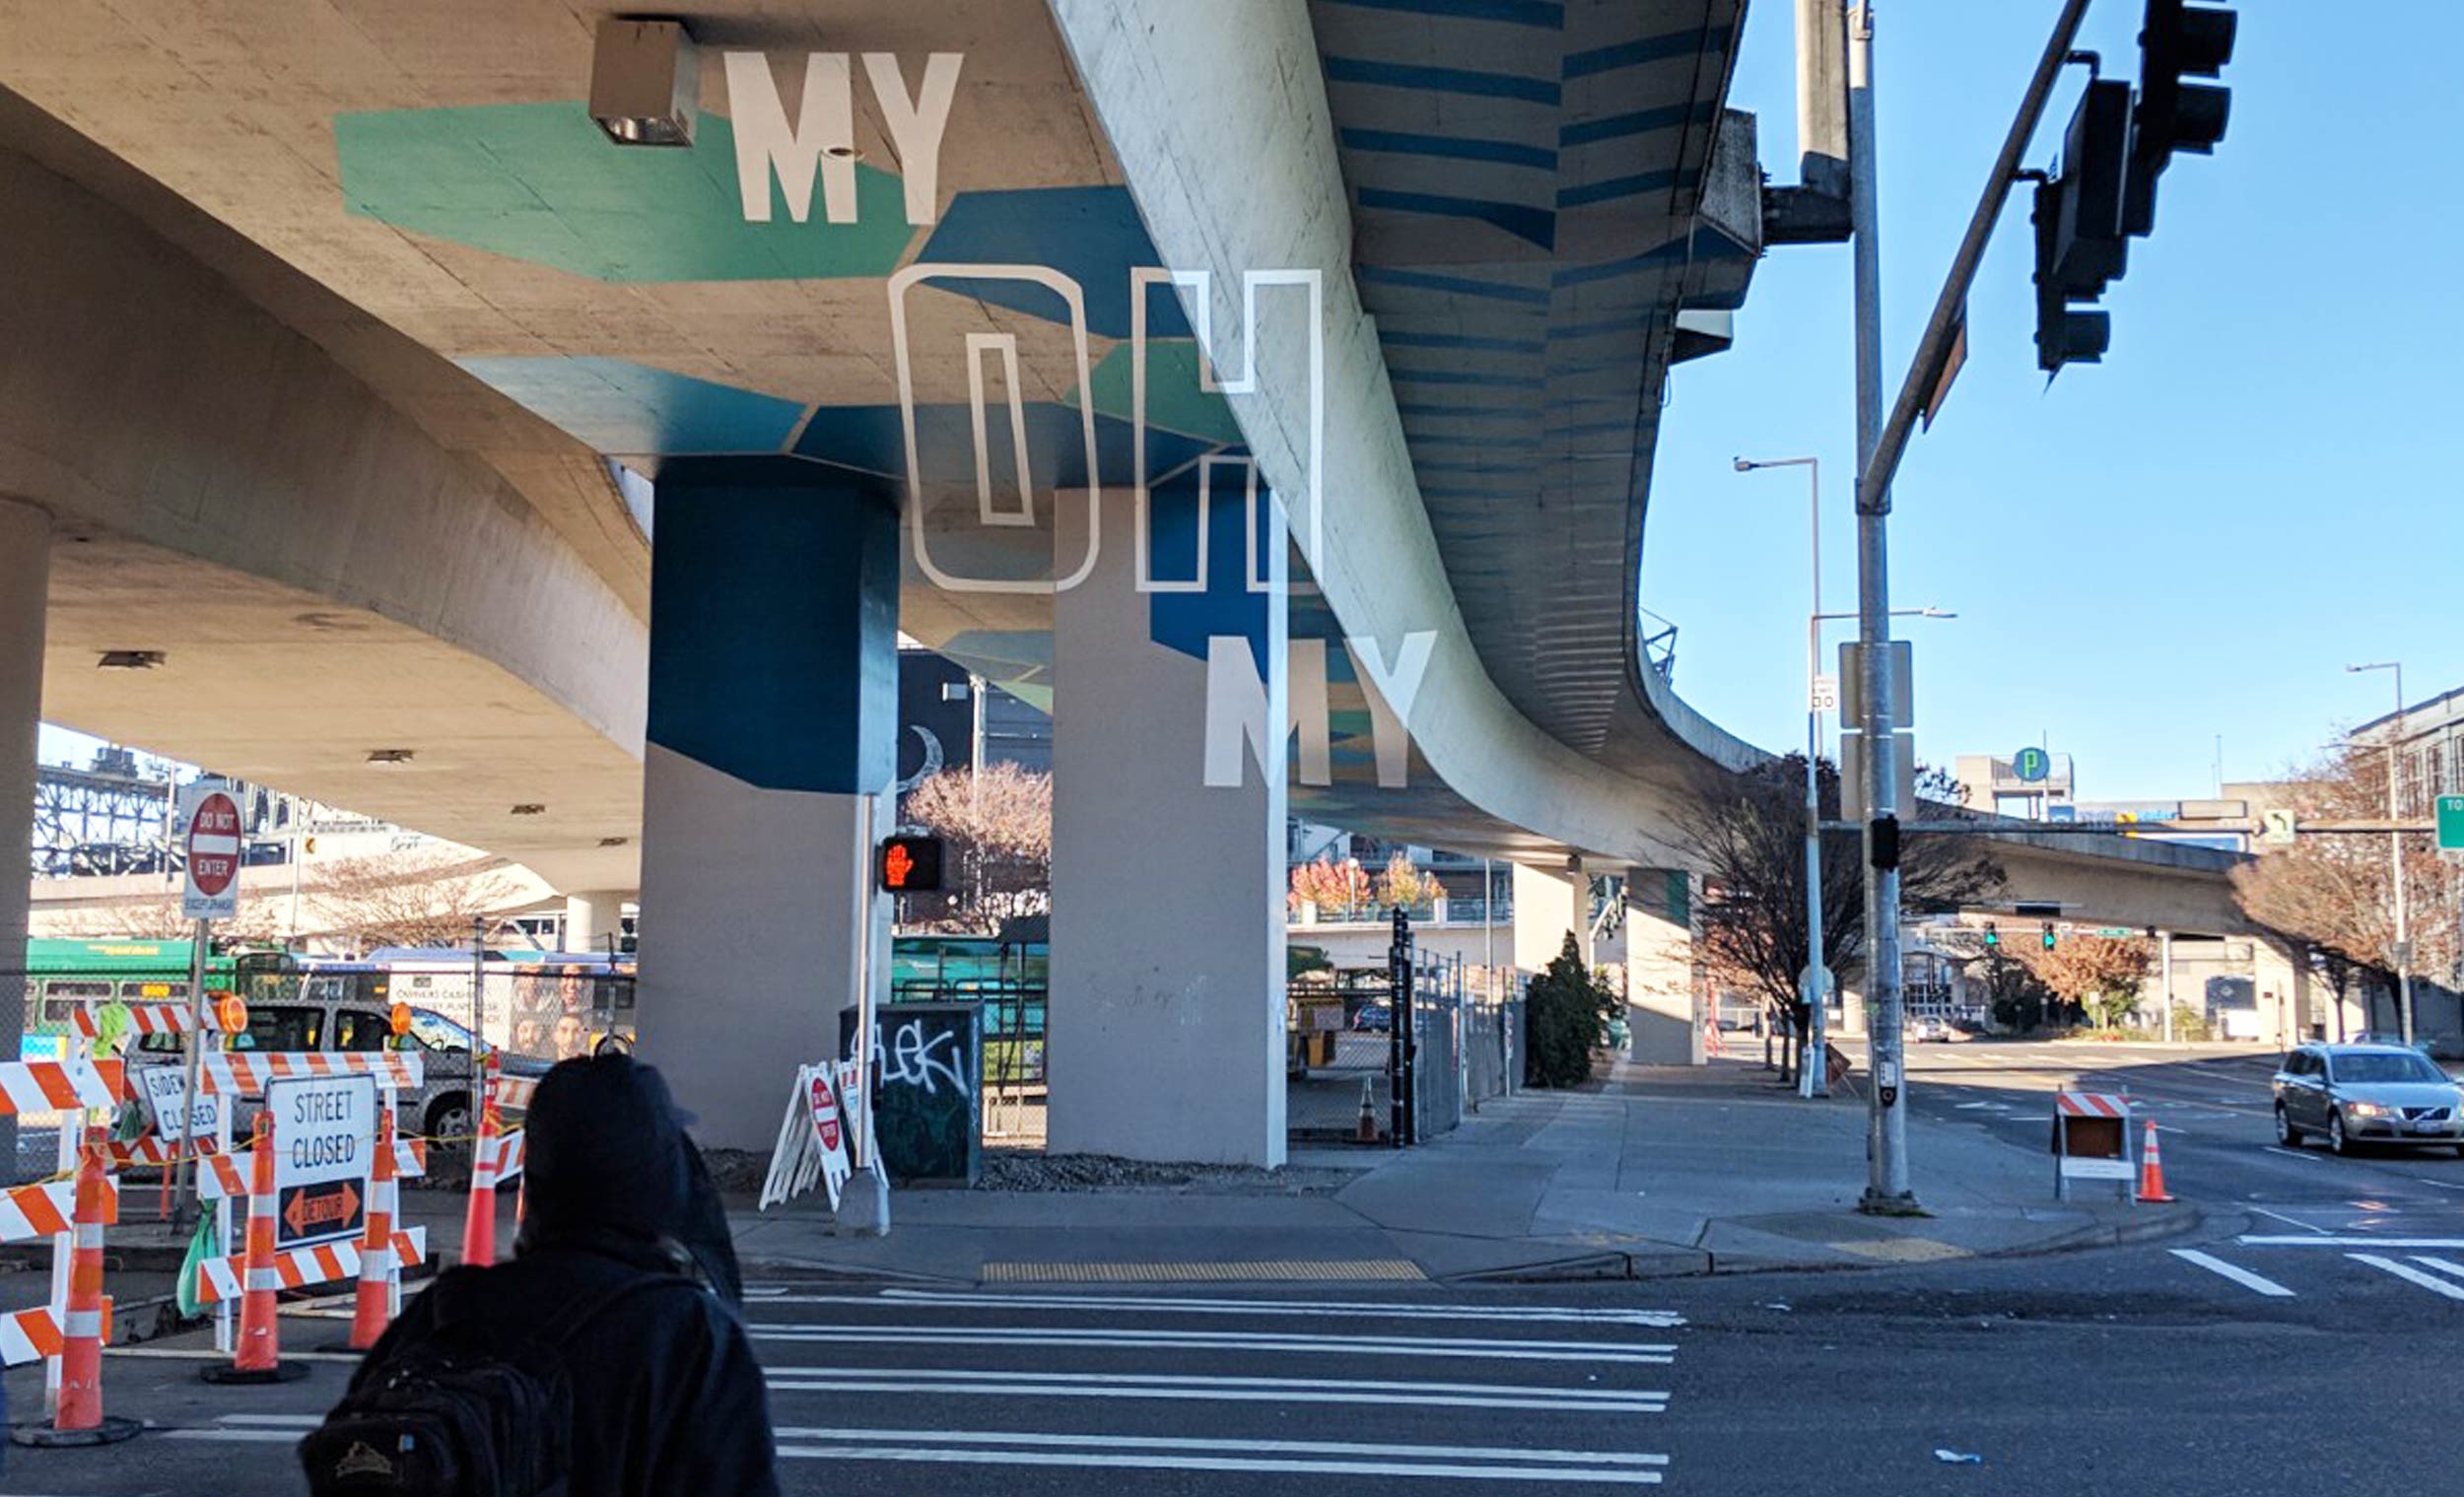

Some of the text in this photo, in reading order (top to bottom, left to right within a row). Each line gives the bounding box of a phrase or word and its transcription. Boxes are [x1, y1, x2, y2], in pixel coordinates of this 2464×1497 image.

[723, 52, 964, 224] MY
[888, 263, 1322, 592] OH
[1203, 631, 1438, 788] MY
[2023, 751, 2039, 779] P
[200, 812, 235, 830] DO NOT
[198, 859, 229, 876] ENTER
[295, 1090, 353, 1123] STREET
[292, 1133, 356, 1170] CLOSED
[303, 1195, 343, 1221] DETOUR
